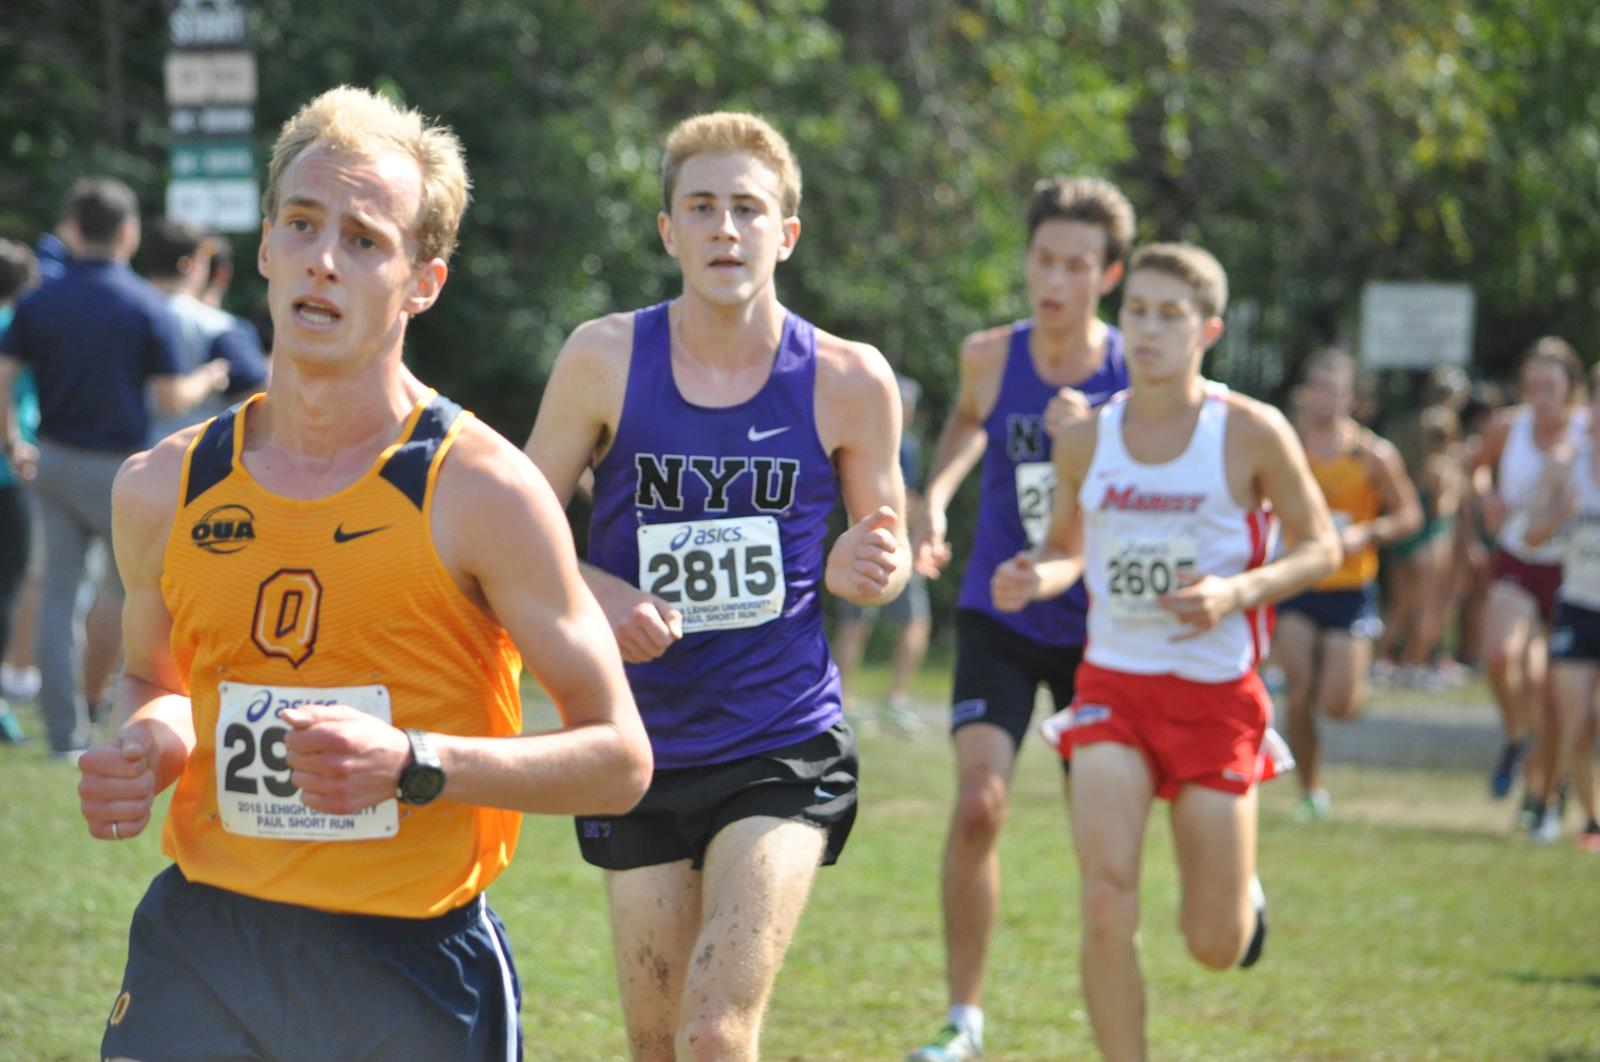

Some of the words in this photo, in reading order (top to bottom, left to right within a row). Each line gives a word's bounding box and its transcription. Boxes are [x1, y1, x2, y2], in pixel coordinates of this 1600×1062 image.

[634, 453, 800, 513] NYU
[191, 520, 256, 541] OUA
[694, 526, 742, 545] asics
[648, 545, 777, 603] 2815
[251, 567, 323, 669] Q
[224, 722, 304, 798] 29
[257, 816, 285, 828] PAUL
[288, 817, 326, 828] SHORT
[330, 818, 355, 829] RUN
[264, 803, 305, 815] LEHIGH
